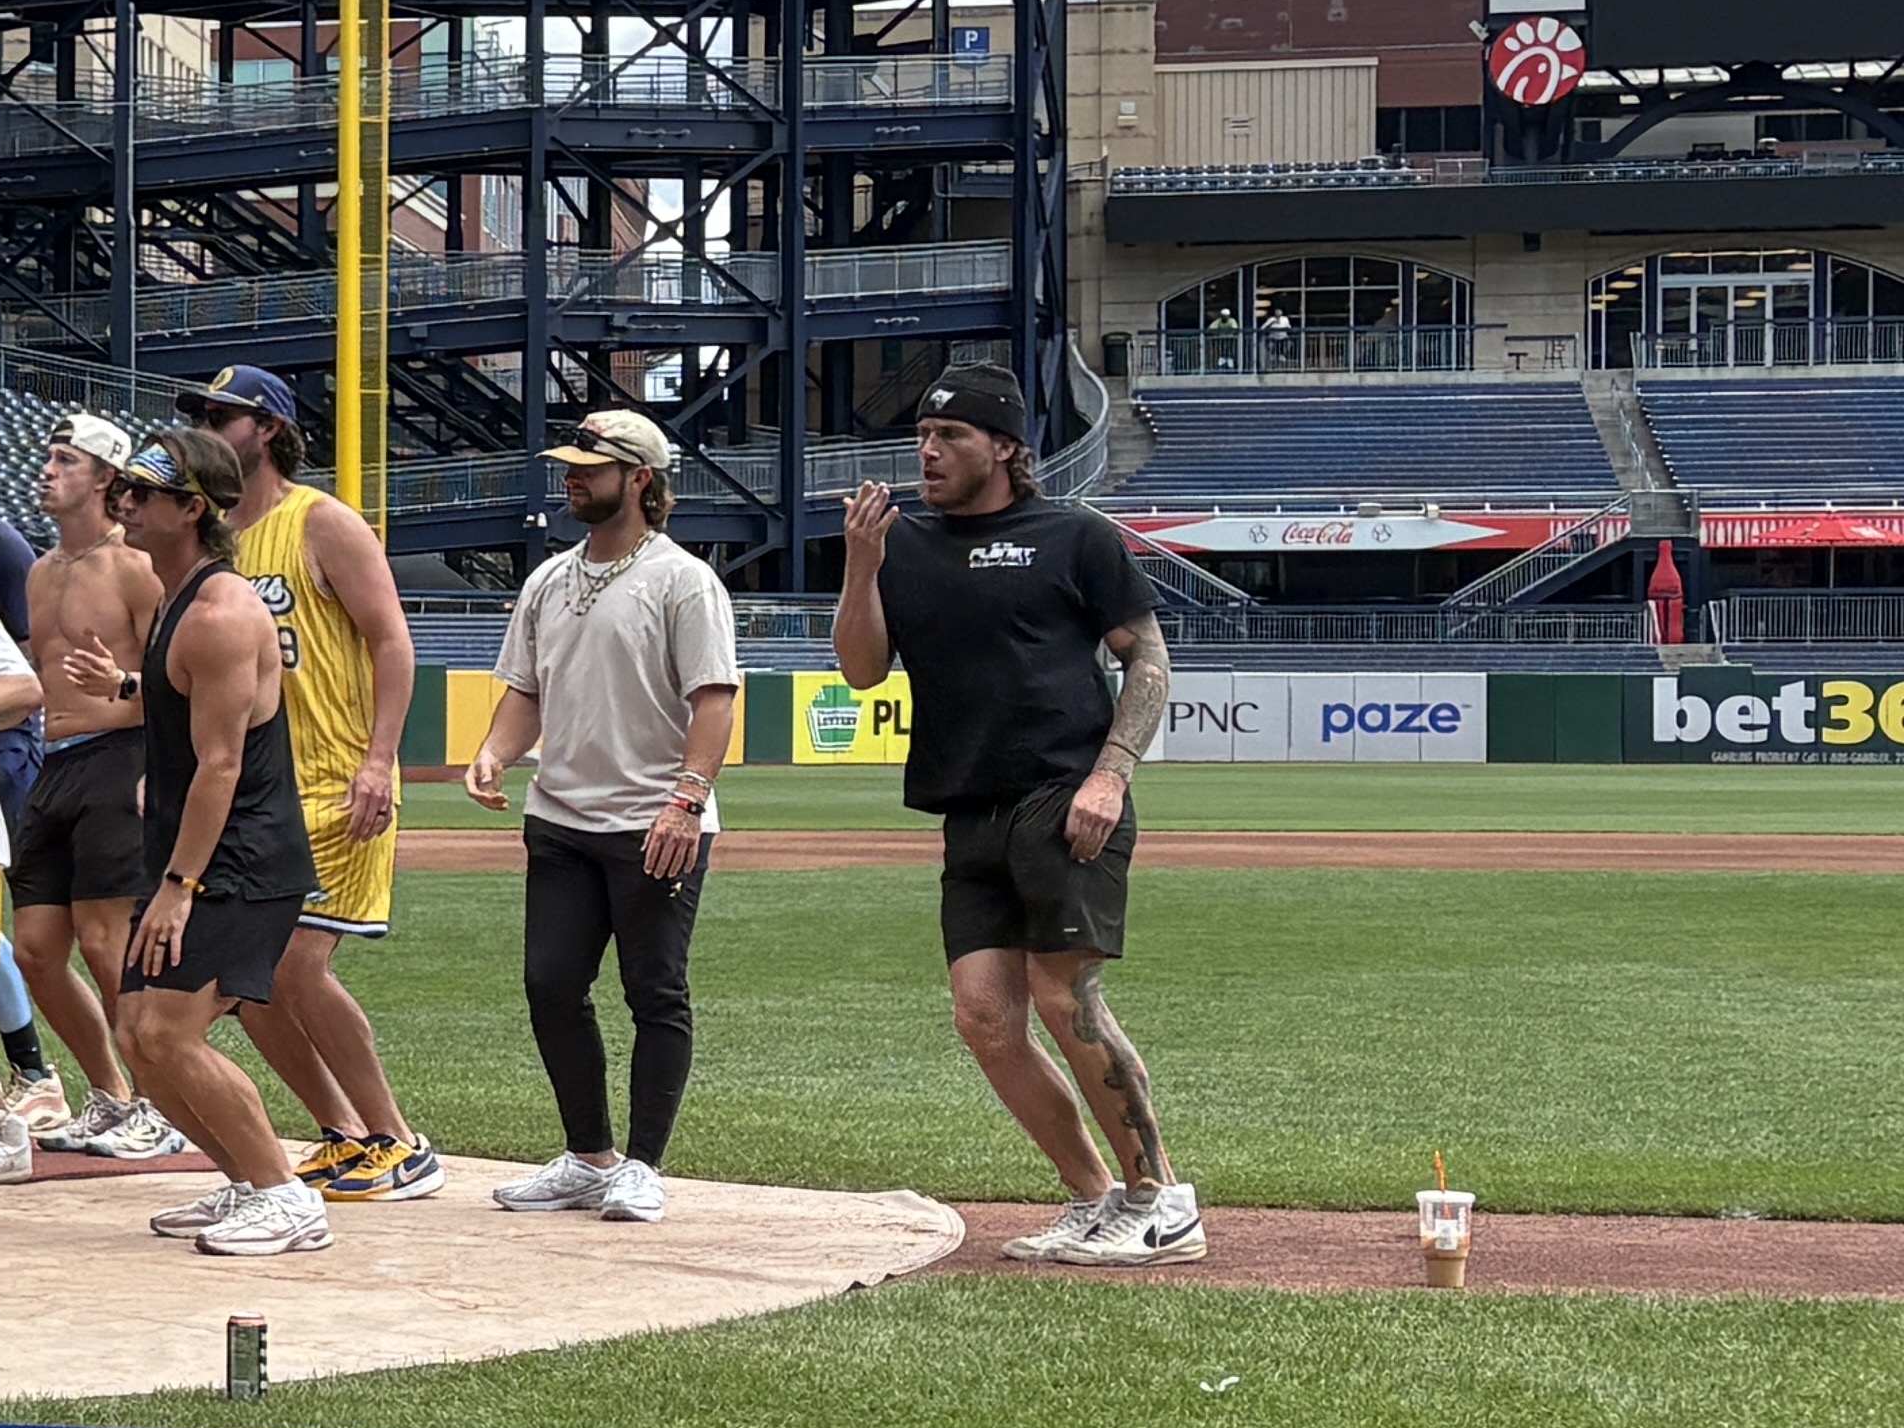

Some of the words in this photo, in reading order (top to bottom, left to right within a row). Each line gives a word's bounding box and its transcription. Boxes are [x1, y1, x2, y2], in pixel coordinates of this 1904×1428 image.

[964, 30, 979, 49] P
[1282, 521, 1354, 545] Coca-Cola
[873, 699, 910, 736] PL
[1168, 702, 1260, 733] PNC
[1321, 702, 1462, 742] paze
